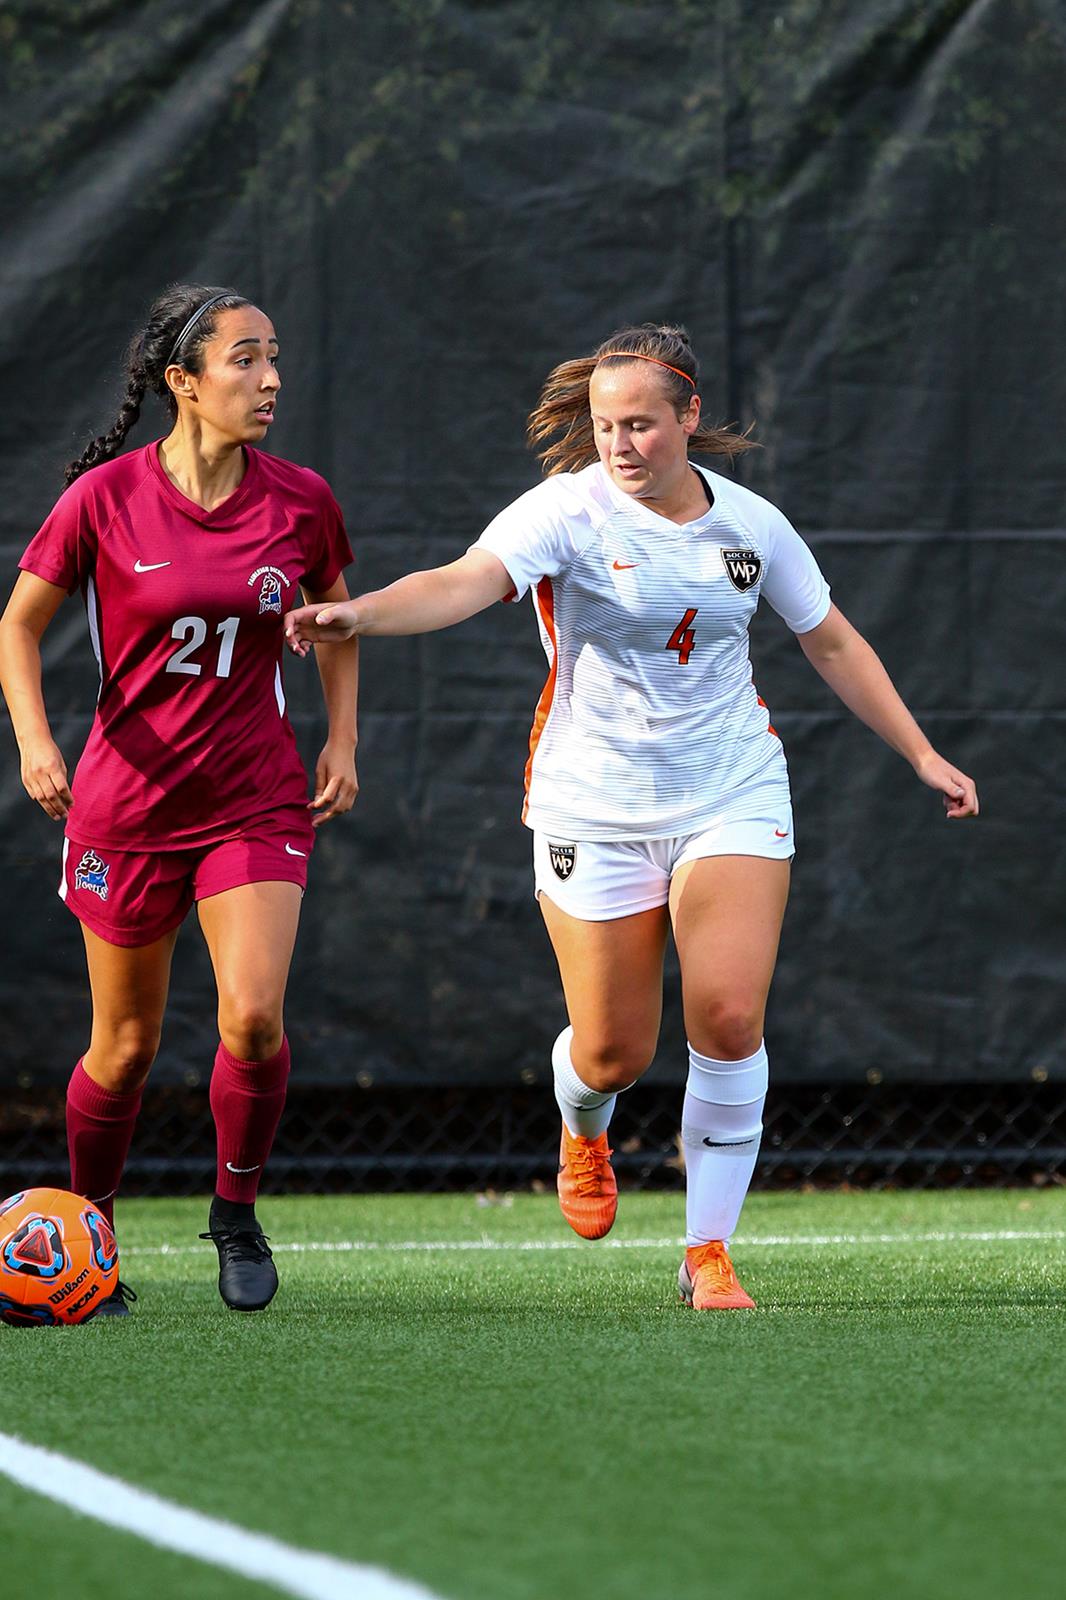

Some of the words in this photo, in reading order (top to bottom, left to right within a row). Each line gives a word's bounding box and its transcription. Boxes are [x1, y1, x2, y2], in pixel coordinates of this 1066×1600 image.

[729, 561, 757, 583] WP
[165, 616, 240, 678] 21
[665, 608, 698, 665] 4
[551, 853, 573, 875] WP
[48, 1268, 90, 1304] Wilson
[66, 1284, 99, 1316] NCAA
